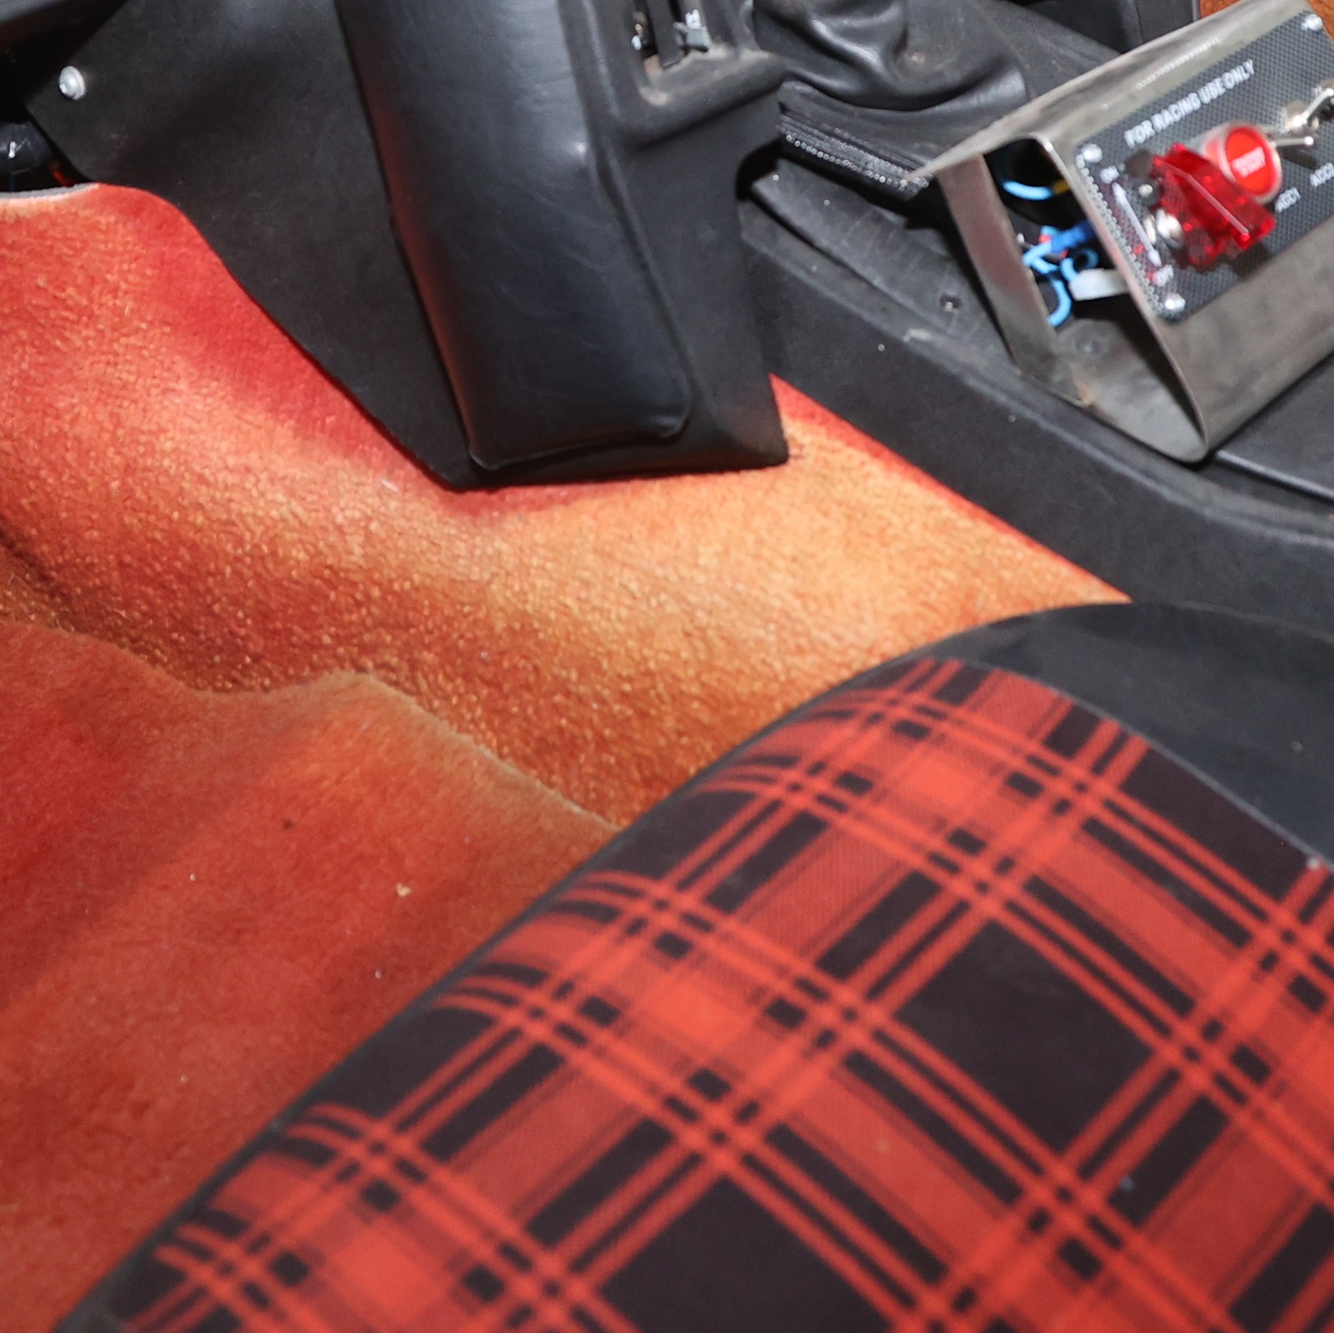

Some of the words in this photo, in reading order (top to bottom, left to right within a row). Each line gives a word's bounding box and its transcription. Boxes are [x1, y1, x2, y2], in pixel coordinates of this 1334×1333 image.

[1124, 119, 1155, 149] FOR
[1151, 92, 1201, 133] RACING
[1197, 77, 1227, 105] USE
[1221, 58, 1255, 90] ONLY
[1274, 186, 1302, 214] ACC1
